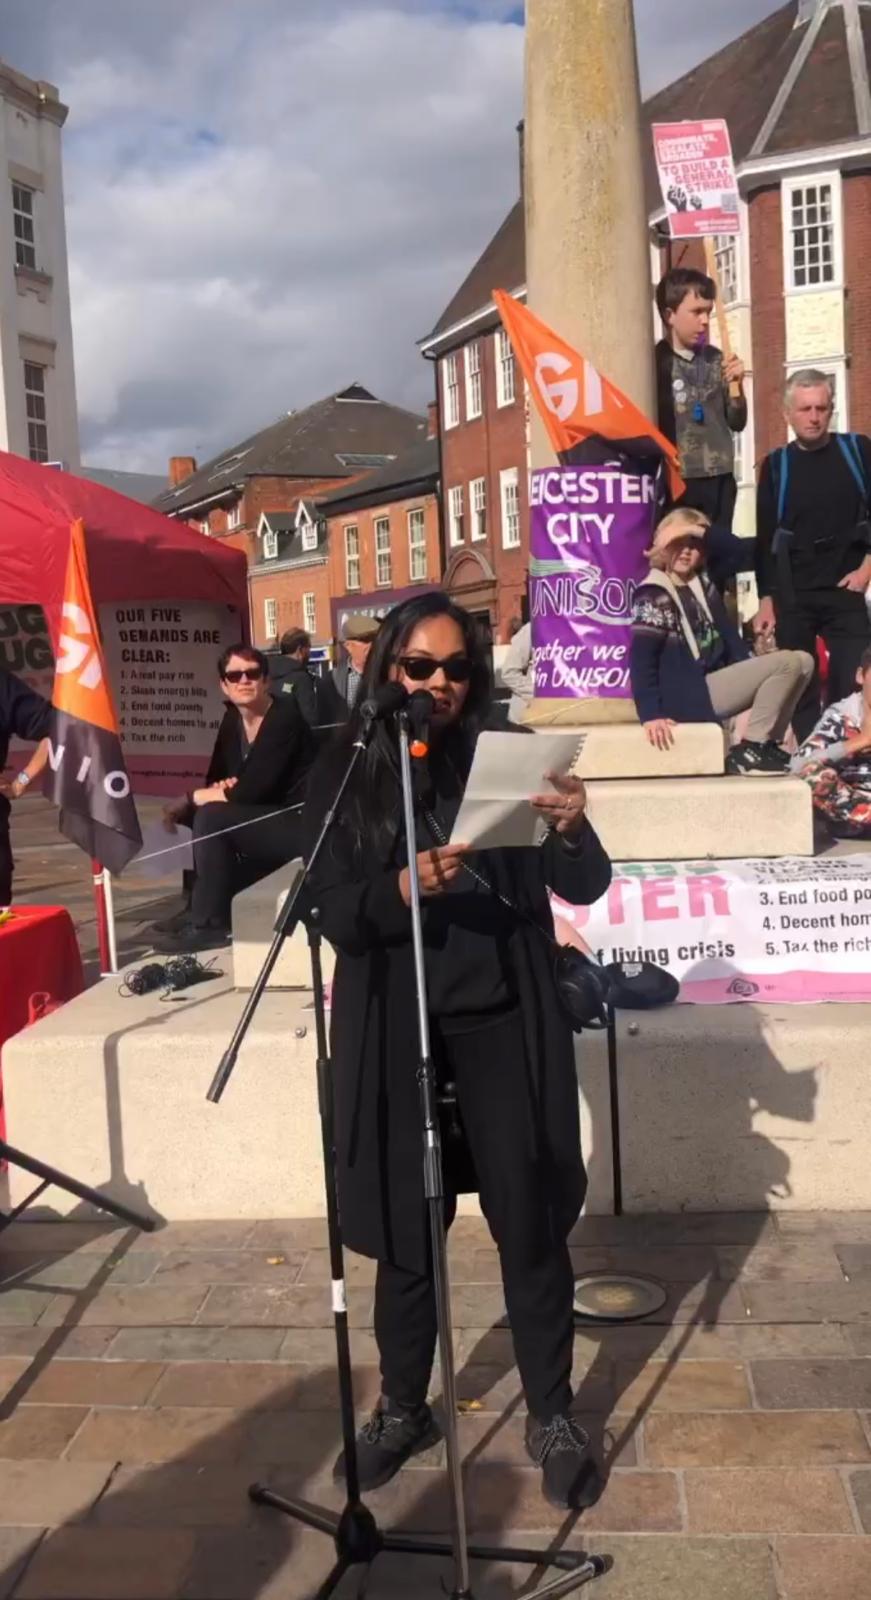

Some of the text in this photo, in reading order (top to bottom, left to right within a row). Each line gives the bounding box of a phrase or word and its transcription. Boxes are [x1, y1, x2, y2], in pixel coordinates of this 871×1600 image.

[660, 159, 729, 176] TO BUILD A
[675, 168, 728, 184] GENERAL
[547, 511, 615, 545] CITY
[116, 608, 182, 623] OUR FIVE
[119, 629, 221, 644] DEMANDS ARE
[121, 649, 171, 663] CLEAR:
[593, 645, 627, 661] we
[158, 672, 175, 681] pay
[149, 733, 165, 742] the
[759, 891, 774, 906] 3.
[778, 889, 808, 905] End
[814, 887, 848, 904] food
[763, 916, 776, 931] 4.
[780, 914, 836, 930] Decent
[612, 946, 670, 966] living
[677, 941, 736, 962] crisis
[765, 941, 780, 956] 5.
[782, 939, 809, 954] Tax
[814, 939, 838, 954] the
